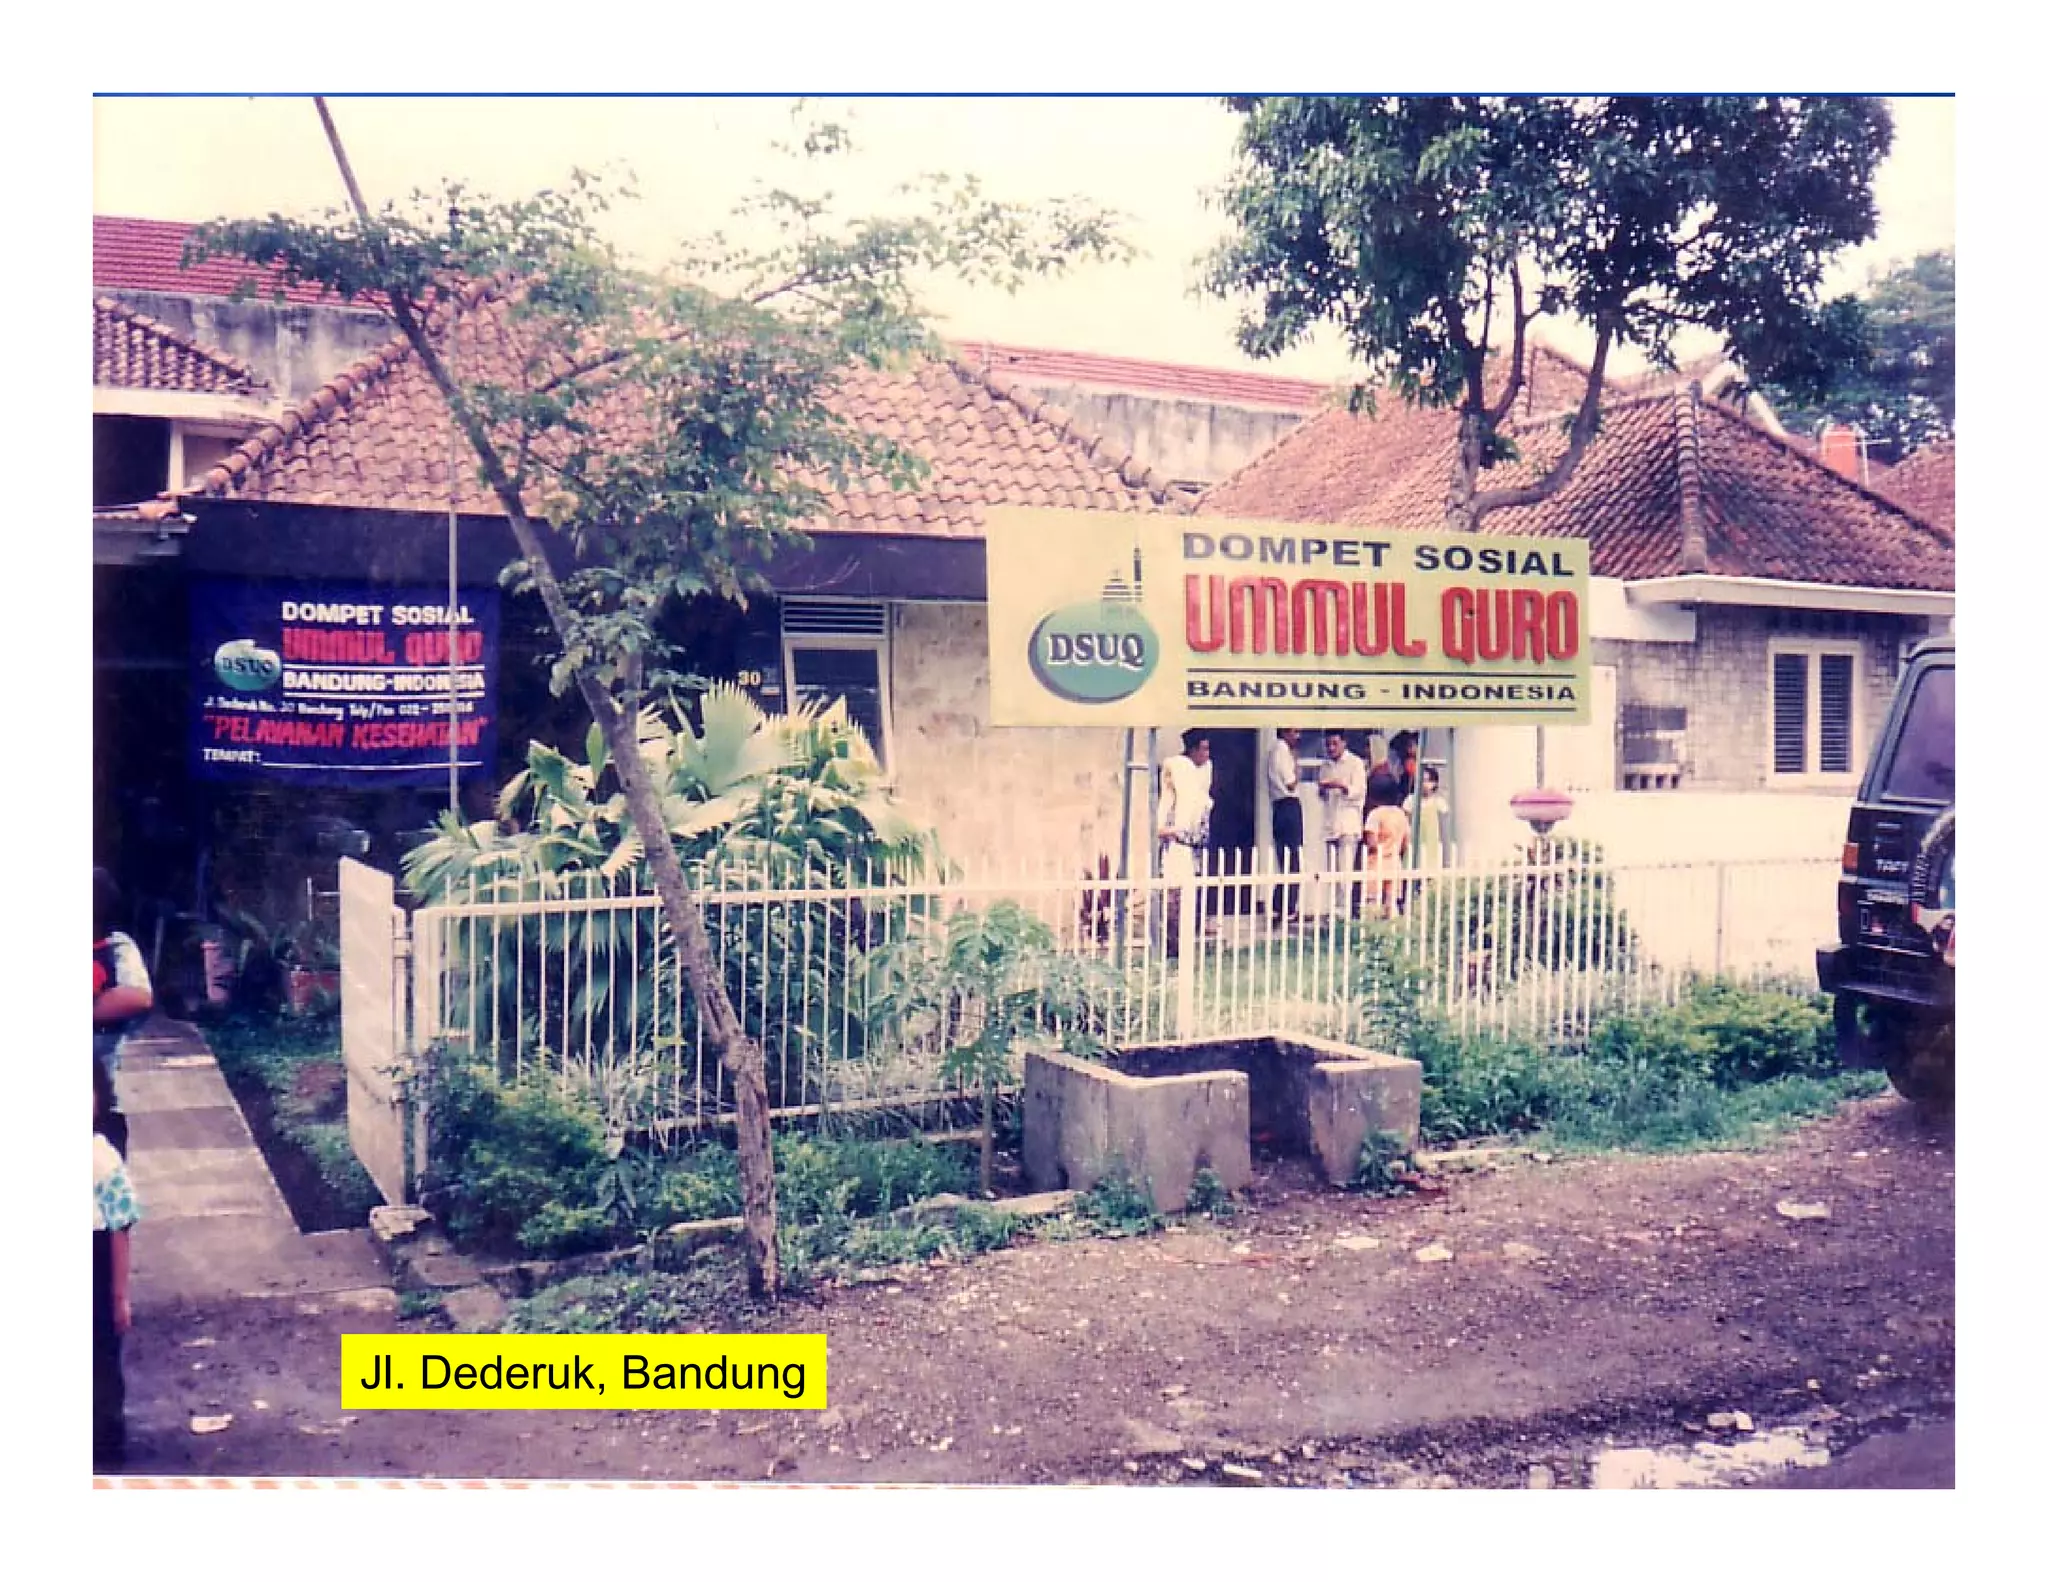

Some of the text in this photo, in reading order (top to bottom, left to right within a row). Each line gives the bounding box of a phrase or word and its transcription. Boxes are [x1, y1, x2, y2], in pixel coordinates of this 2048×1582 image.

[1182, 532, 1576, 577] DOMPET SOSIAL
[281, 600, 385, 626] DOMPET
[1185, 573, 1428, 658] UMMUL
[1046, 631, 1146, 672] DSUQ
[1187, 680, 1367, 698] BANDUNG
[1402, 683, 1577, 700] INDONESIA
